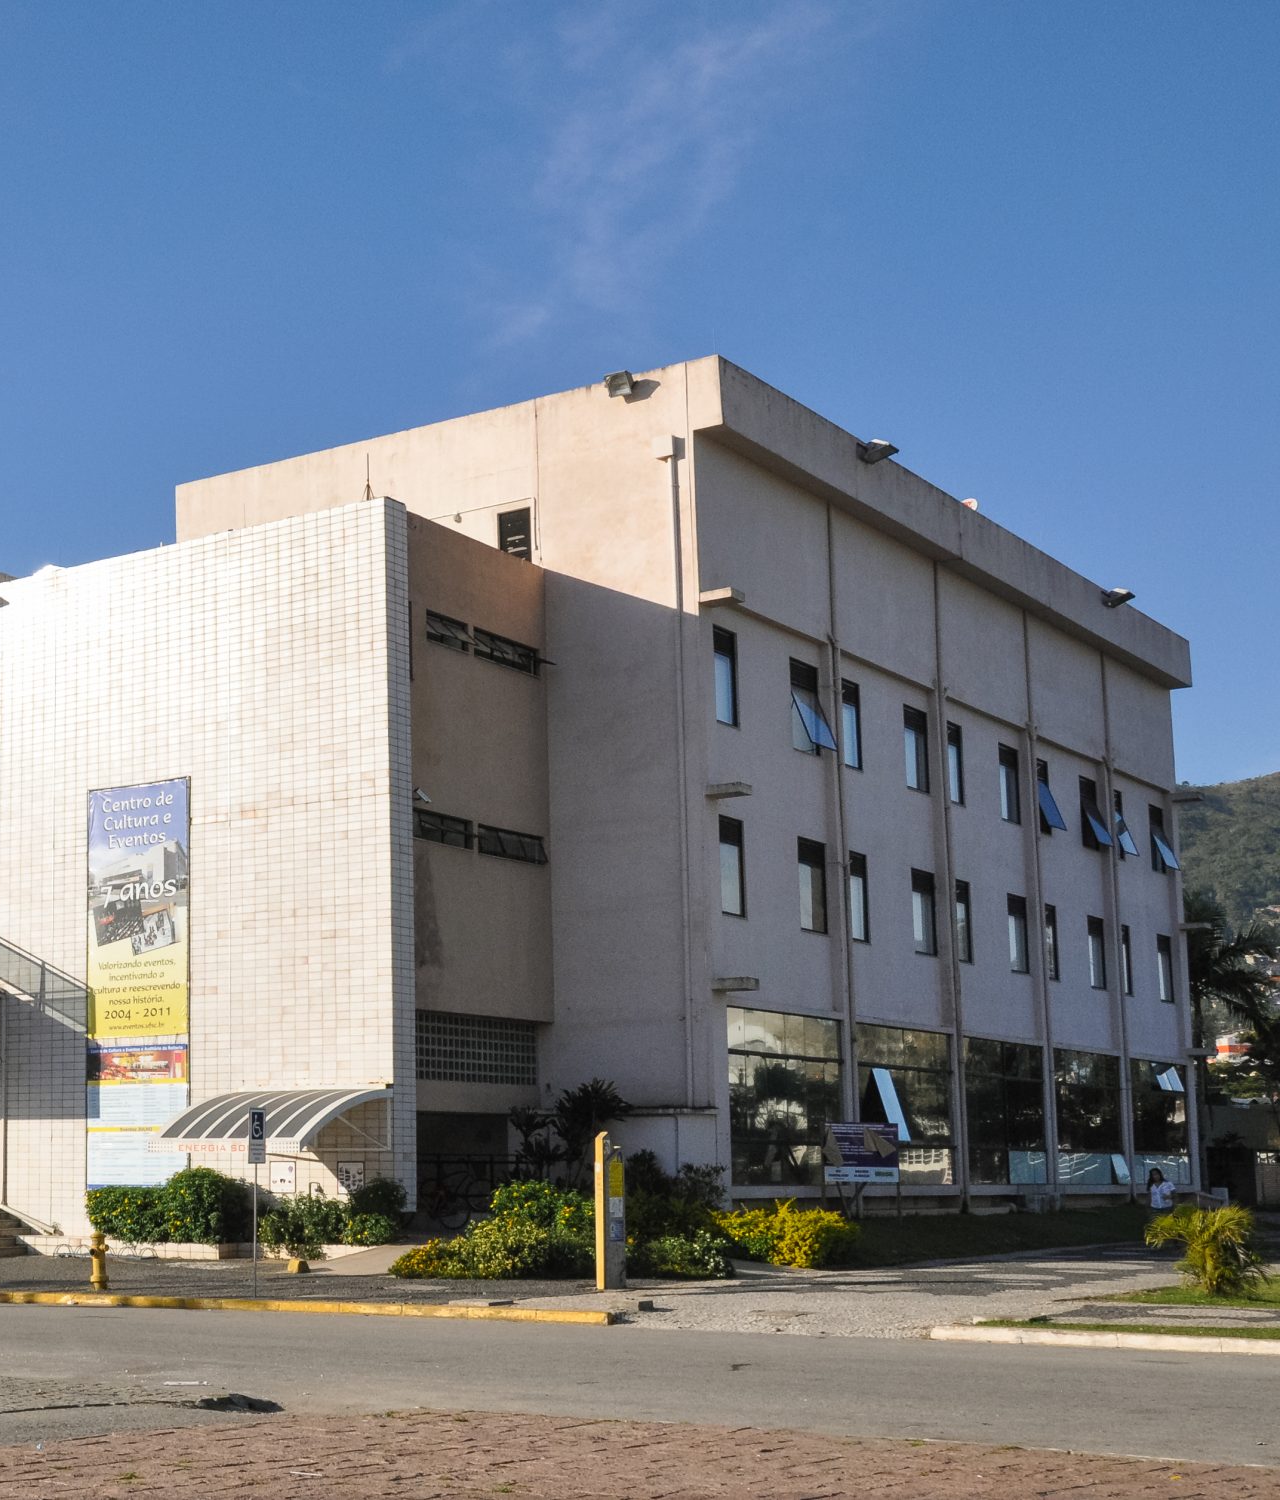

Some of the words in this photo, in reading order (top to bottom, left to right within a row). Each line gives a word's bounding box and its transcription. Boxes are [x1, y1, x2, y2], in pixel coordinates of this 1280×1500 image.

[102, 796, 151, 813] Centro
[154, 791, 173, 805] de
[103, 813, 159, 831] Cultura
[163, 812, 172, 824] e
[109, 831, 166, 849] Eventos
[100, 886, 112, 909] 7
[120, 878, 177, 901] anos
[98, 960, 142, 970] Valorizando
[109, 970, 158, 981] incentivando
[93, 986, 120, 995] cultura
[129, 981, 181, 992] reescrevendo
[109, 998, 131, 1006] nossa
[133, 994, 164, 1004] história.
[104, 1009, 131, 1020] 2004
[143, 1006, 171, 1017] 2011
[178, 1144, 226, 1152] ENERGIA
